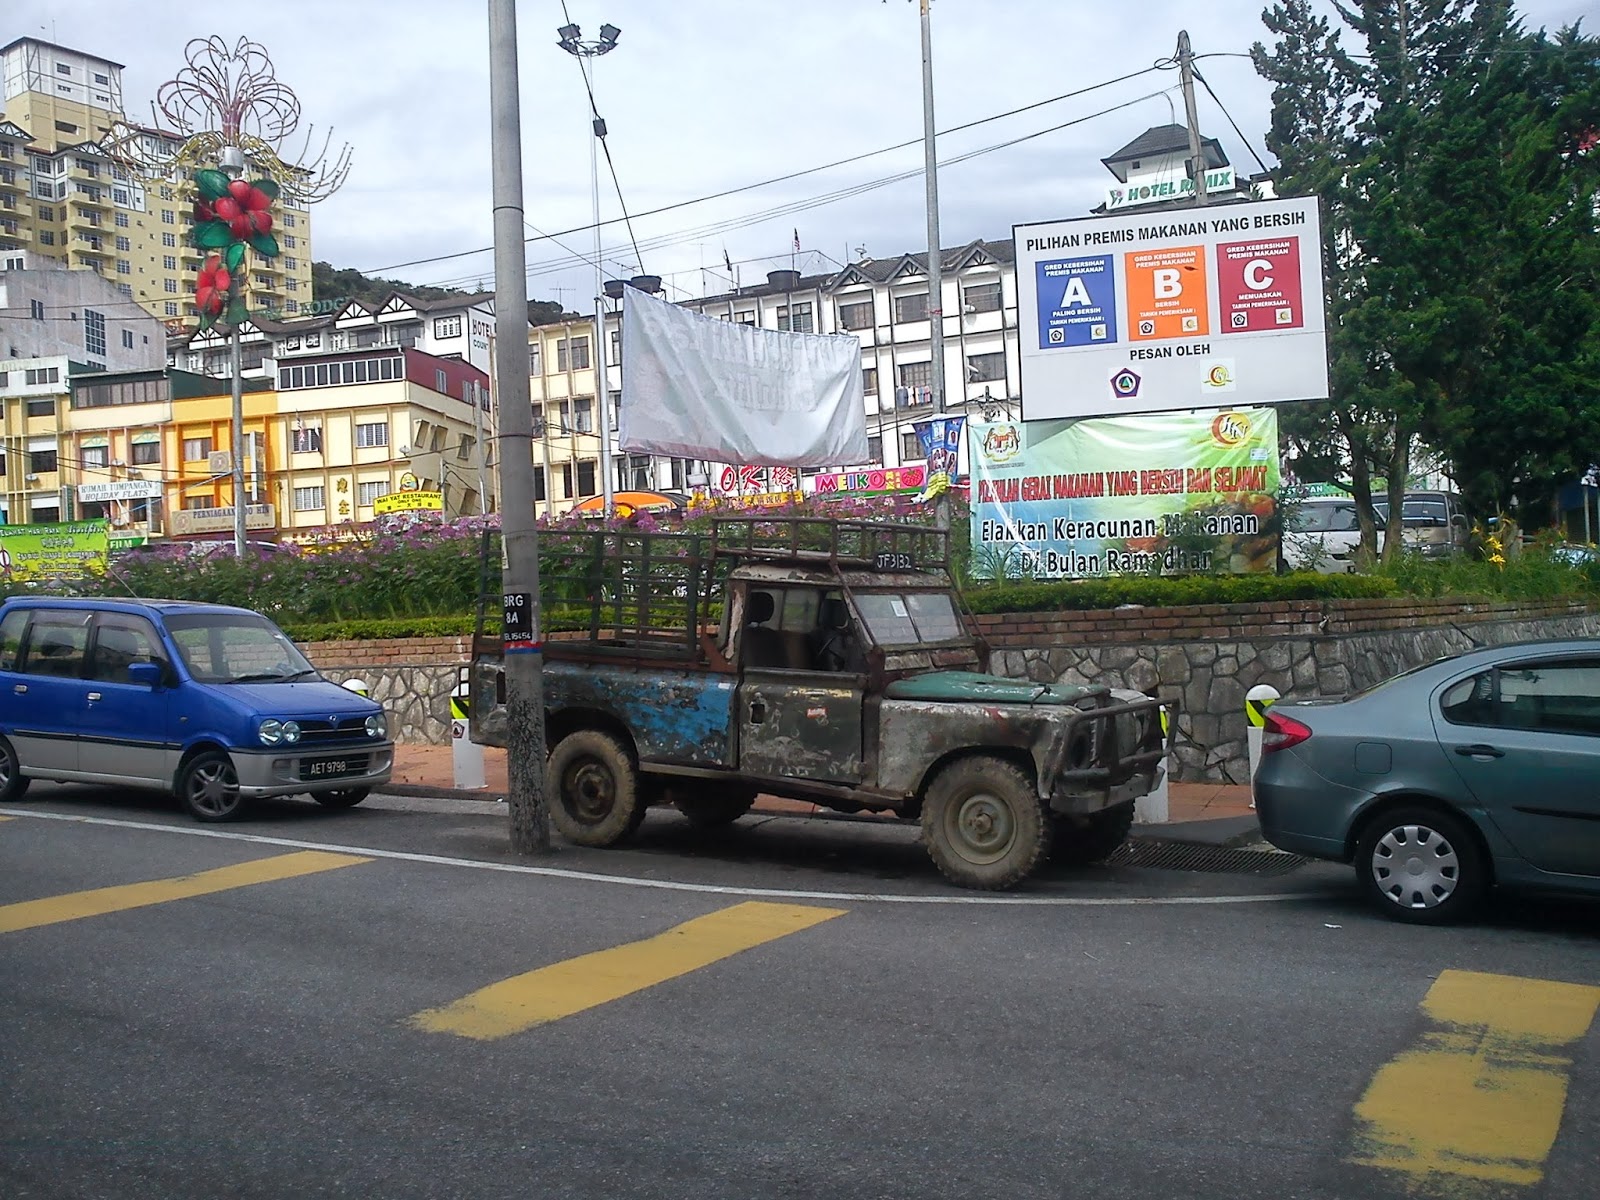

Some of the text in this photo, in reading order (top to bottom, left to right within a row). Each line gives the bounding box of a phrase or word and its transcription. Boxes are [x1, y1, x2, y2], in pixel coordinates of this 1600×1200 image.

[1128, 170, 1232, 201] HOTEL RMIX
[1026, 211, 1305, 251] PILIHAN PREMIS MAKANAN YANG BERSIH
[1246, 241, 1290, 251] KEBERSIHAN
[1254, 248, 1289, 257] MAKANAN
[1154, 250, 1196, 260] KEBERSIHAN
[1161, 257, 1195, 266] MAKANAN
[1063, 259, 1105, 269] KEBERSIHAN
[1071, 266, 1104, 275] MAKANAN
[1243, 258, 1274, 290] C
[1153, 268, 1183, 299] B
[1060, 277, 1092, 308] A
[1238, 291, 1282, 300] MEMUASKAN
[1052, 307, 1101, 317] PALING BERSIH
[1130, 344, 1211, 360] PESAN OLEH
[819, 471, 886, 492] MEIKO
[1021, 475, 1051, 501] GERAI
[1053, 472, 1104, 499] MAKANAN
[1106, 470, 1138, 496] YANG
[1140, 469, 1184, 495] BERSIH
[1187, 468, 1212, 493] DAN
[1214, 465, 1268, 493] SELAMAT
[85, 489, 149, 501] HOLIDAY FLATS
[0, 528, 26, 537] ELAMAT
[1054, 517, 1156, 540] Keracunan
[1047, 549, 1099, 573] Bulan
[505, 611, 519, 624] 8A
